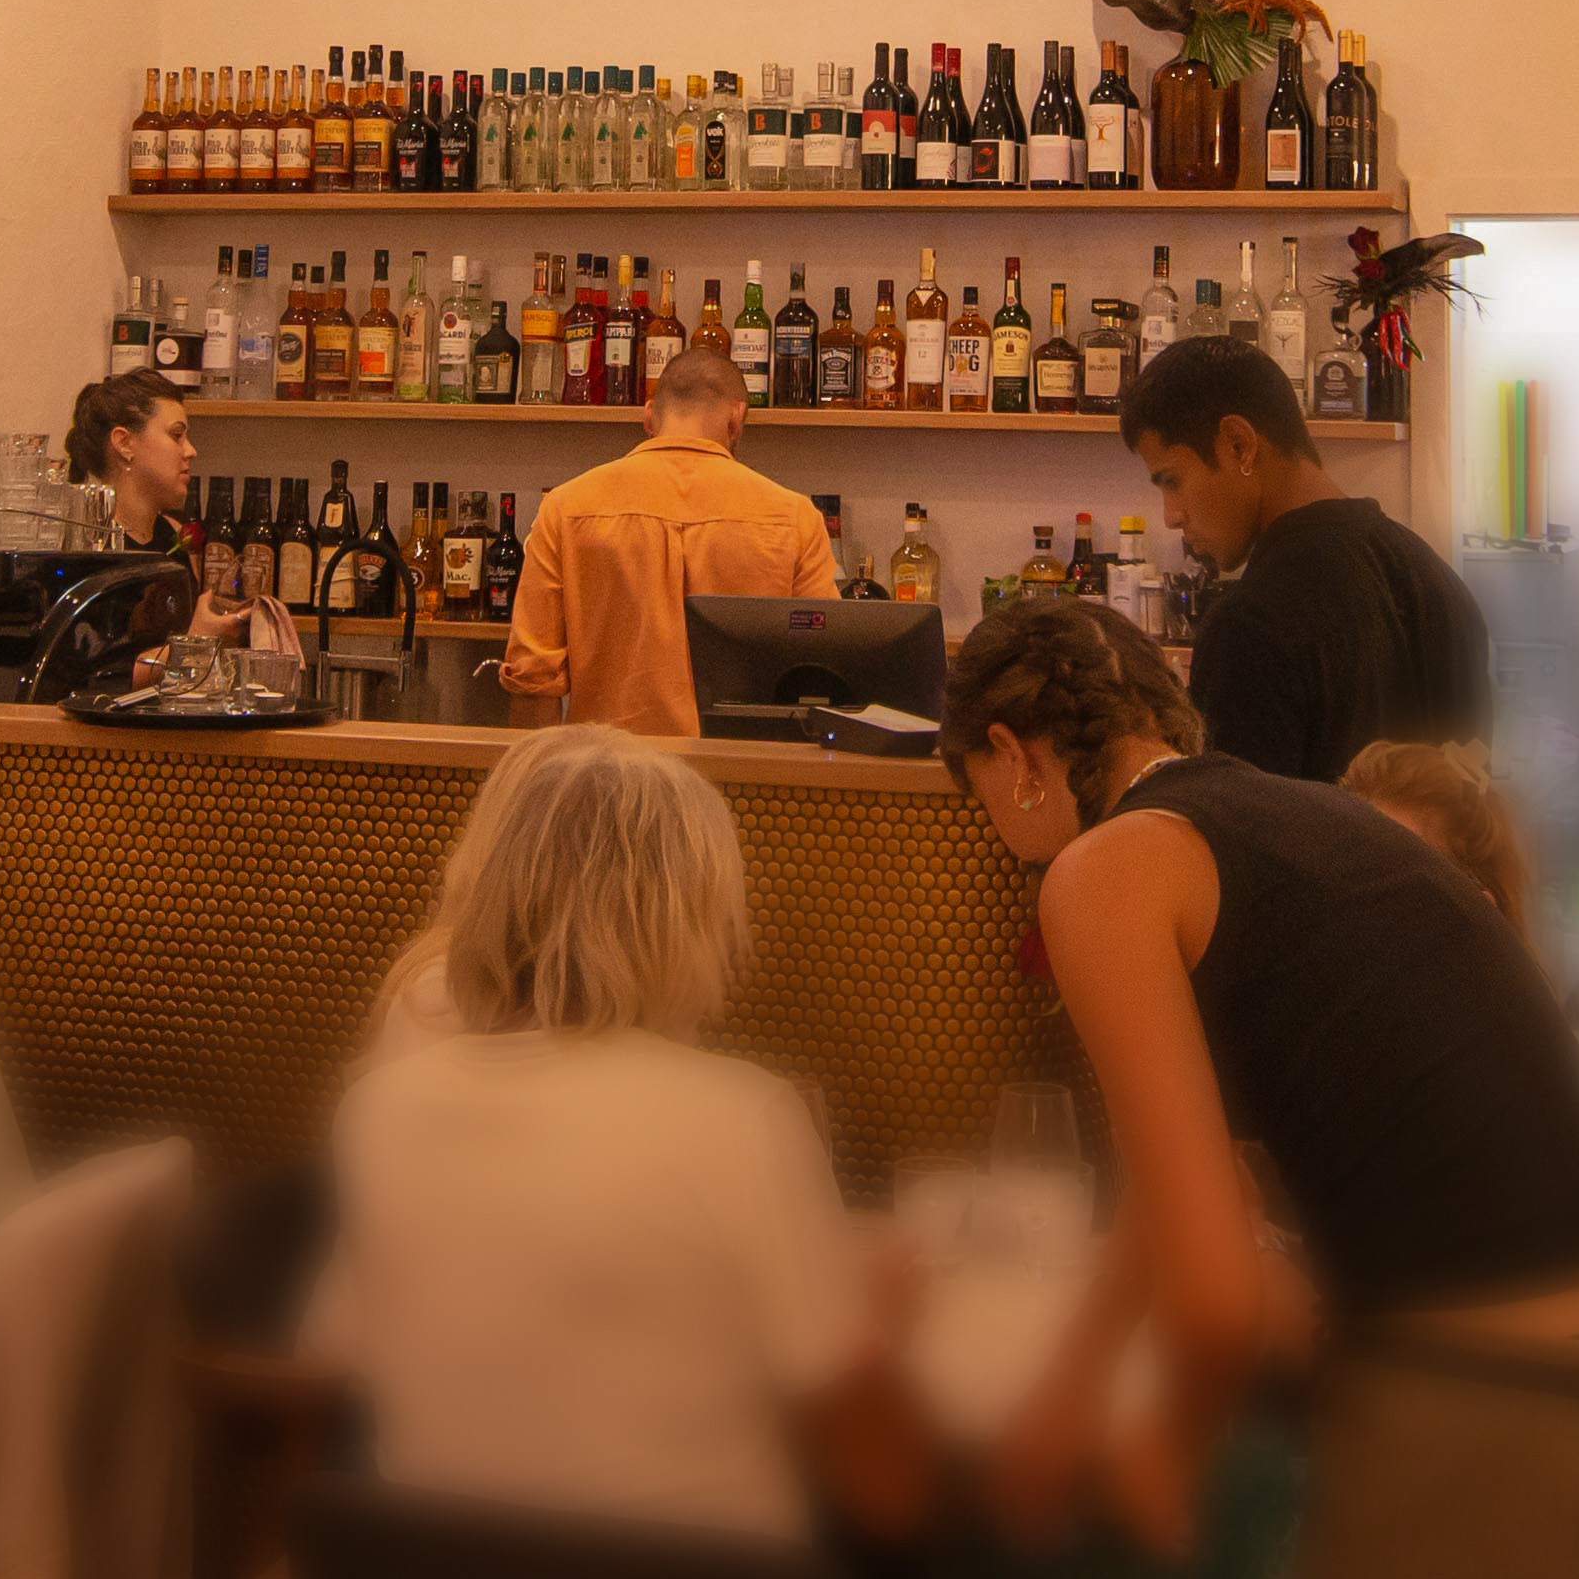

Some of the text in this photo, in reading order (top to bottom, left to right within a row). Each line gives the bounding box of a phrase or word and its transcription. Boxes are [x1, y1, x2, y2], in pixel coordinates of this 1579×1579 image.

[993, 330, 1030, 341] JAMESON
[948, 354, 980, 372] DG
[446, 571, 472, 582] Mac.
